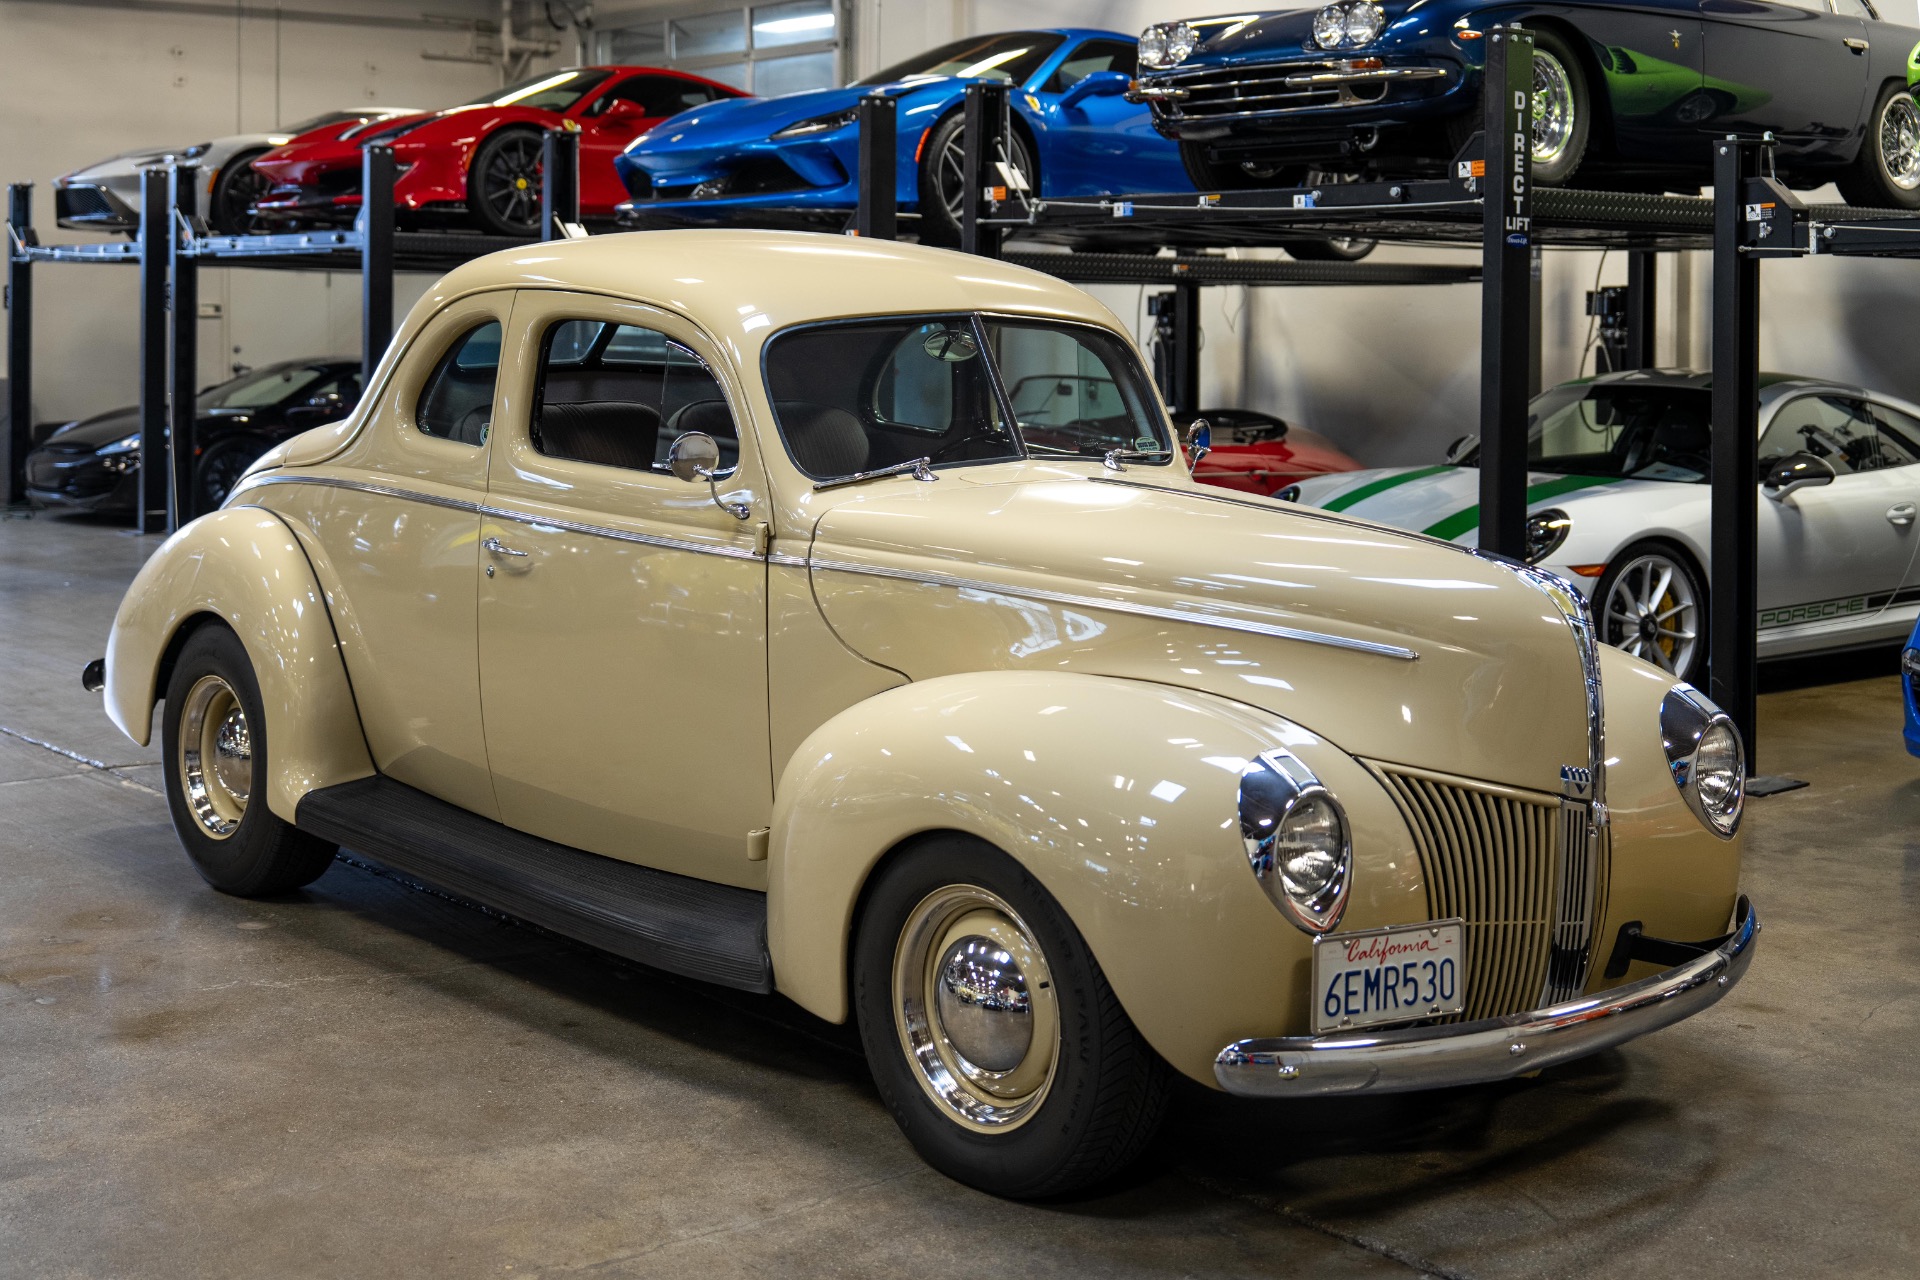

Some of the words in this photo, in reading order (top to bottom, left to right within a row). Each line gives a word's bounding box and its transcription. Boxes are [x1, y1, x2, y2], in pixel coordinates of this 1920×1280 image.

[1513, 91, 1527, 215] DIRECT
[1505, 216, 1530, 231] LIFT
[1760, 597, 1865, 626] PORSCHE
[1347, 934, 1439, 965] California
[1324, 957, 1455, 1017] 6EMR530
